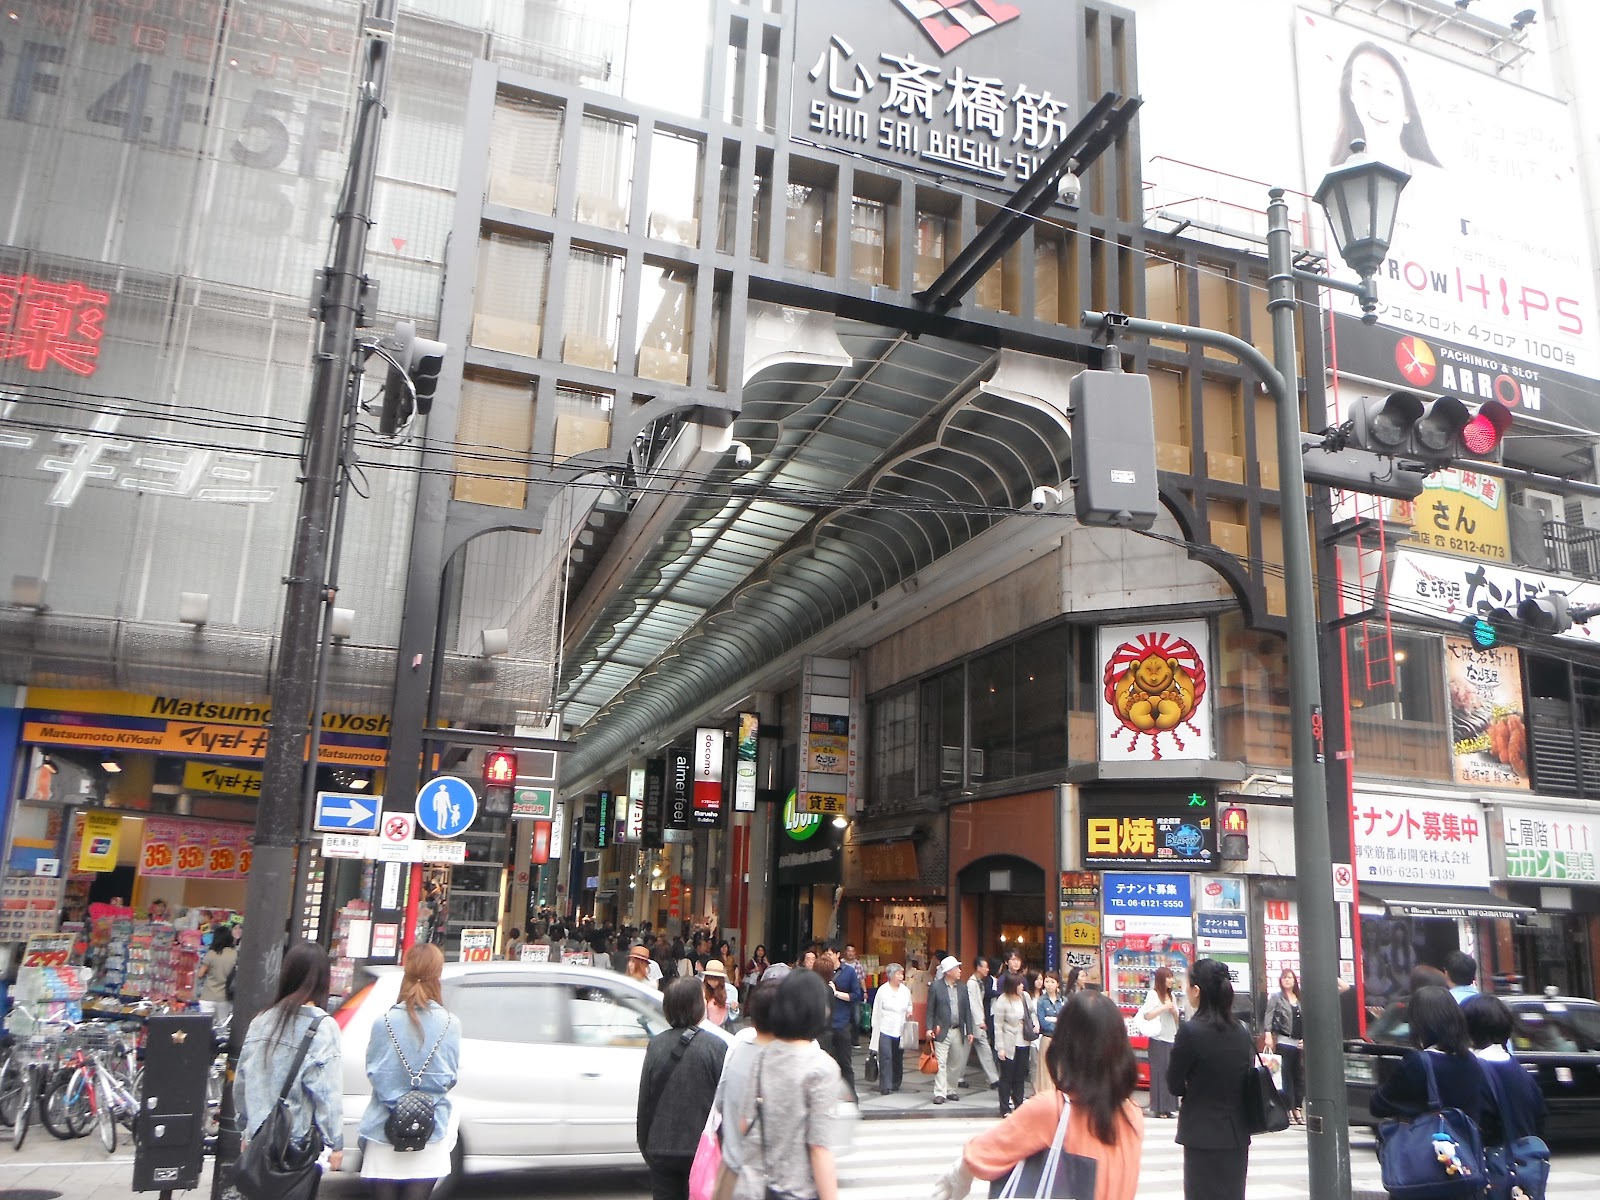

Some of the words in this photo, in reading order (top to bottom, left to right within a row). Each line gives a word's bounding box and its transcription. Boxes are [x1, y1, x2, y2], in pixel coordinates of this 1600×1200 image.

[808, 33, 1069, 152] 心斎橋筋
[810, 98, 869, 142] SHIN
[879, 116, 919, 156] SAI
[1468, 325, 1516, 348] 4フロア
[1524, 338, 1576, 367] 1100台
[1440, 347, 1498, 371] PACHINKO
[1501, 363, 1511, 374] &
[1511, 365, 1539, 381] SLOT
[1442, 363, 1542, 411] ARROW
[1432, 500, 1477, 534] さん
[1450, 538, 1505, 557] 6212-4773
[1416, 578, 1460, 600] 道頓堀
[151, 695, 272, 725] Matsumo
[40, 727, 114, 742] Matsumoto
[116, 733, 162, 745] KiYoshi
[703, 734, 713, 776] docomo
[673, 756, 690, 823] aimerfeel
[1088, 817, 1155, 853] 日焼
[1505, 818, 1548, 848] 上層階
[1379, 865, 1455, 880] 06-6251-9139
[1505, 848, 1595, 880] テナント募集
[1111, 899, 1126, 907] TEL
[1128, 899, 1184, 908] 06-6121-5550
[1116, 883, 1178, 895] テナント募集
[1073, 928, 1088, 938] さん
